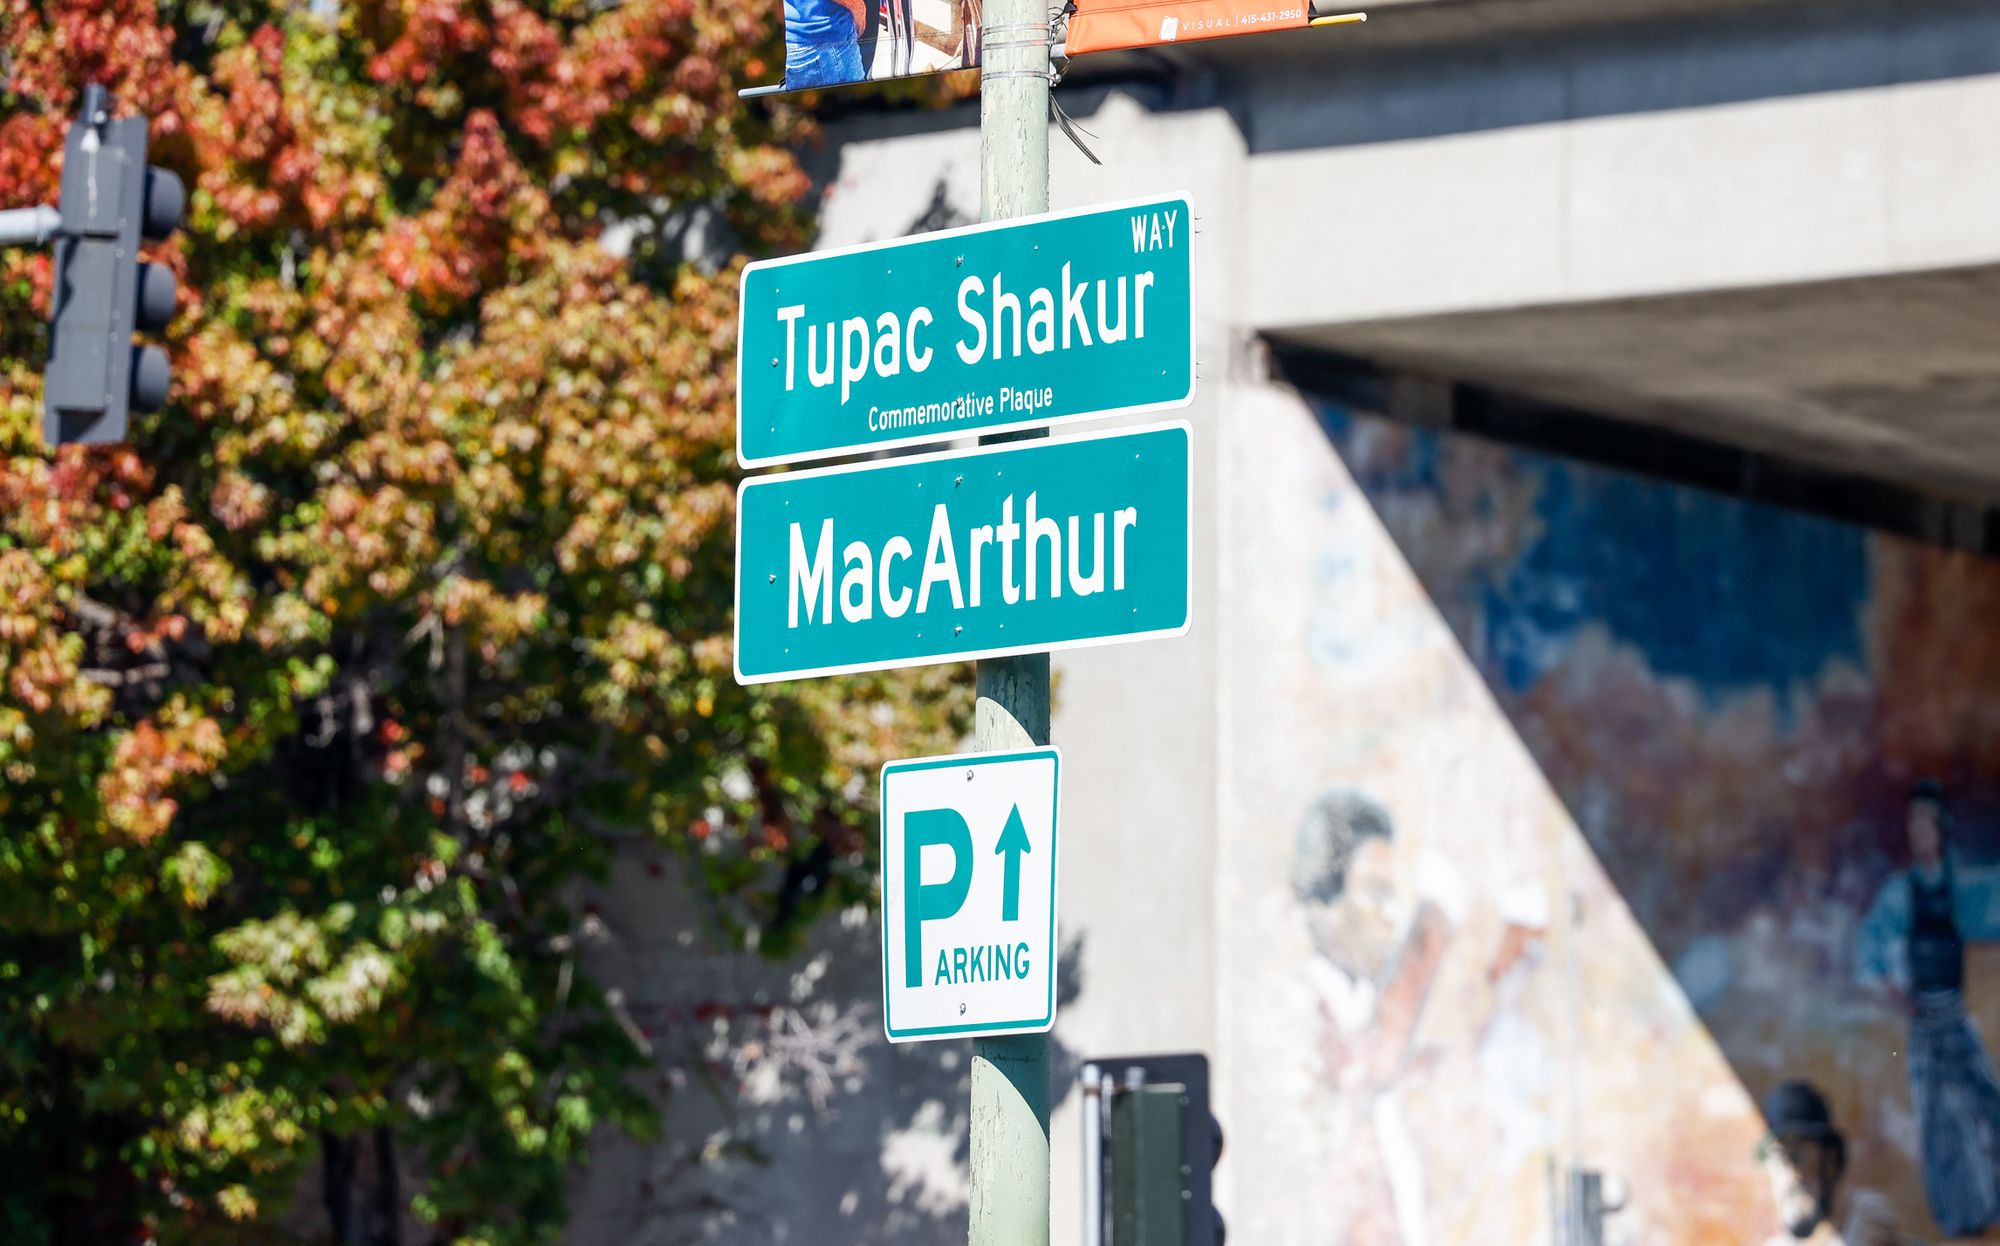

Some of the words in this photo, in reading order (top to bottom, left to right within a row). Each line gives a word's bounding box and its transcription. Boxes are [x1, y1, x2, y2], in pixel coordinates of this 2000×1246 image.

[1182, 18, 1231, 32] VISUAL
[1241, 8, 1302, 25] 415-431-2950
[1131, 209, 1178, 254] WAY
[776, 303, 934, 406] Tupac
[955, 260, 1155, 366] Shakur
[868, 396, 994, 432] Commemorative
[999, 386, 1053, 417] Plaque
[787, 490, 1138, 629] MacArthur
